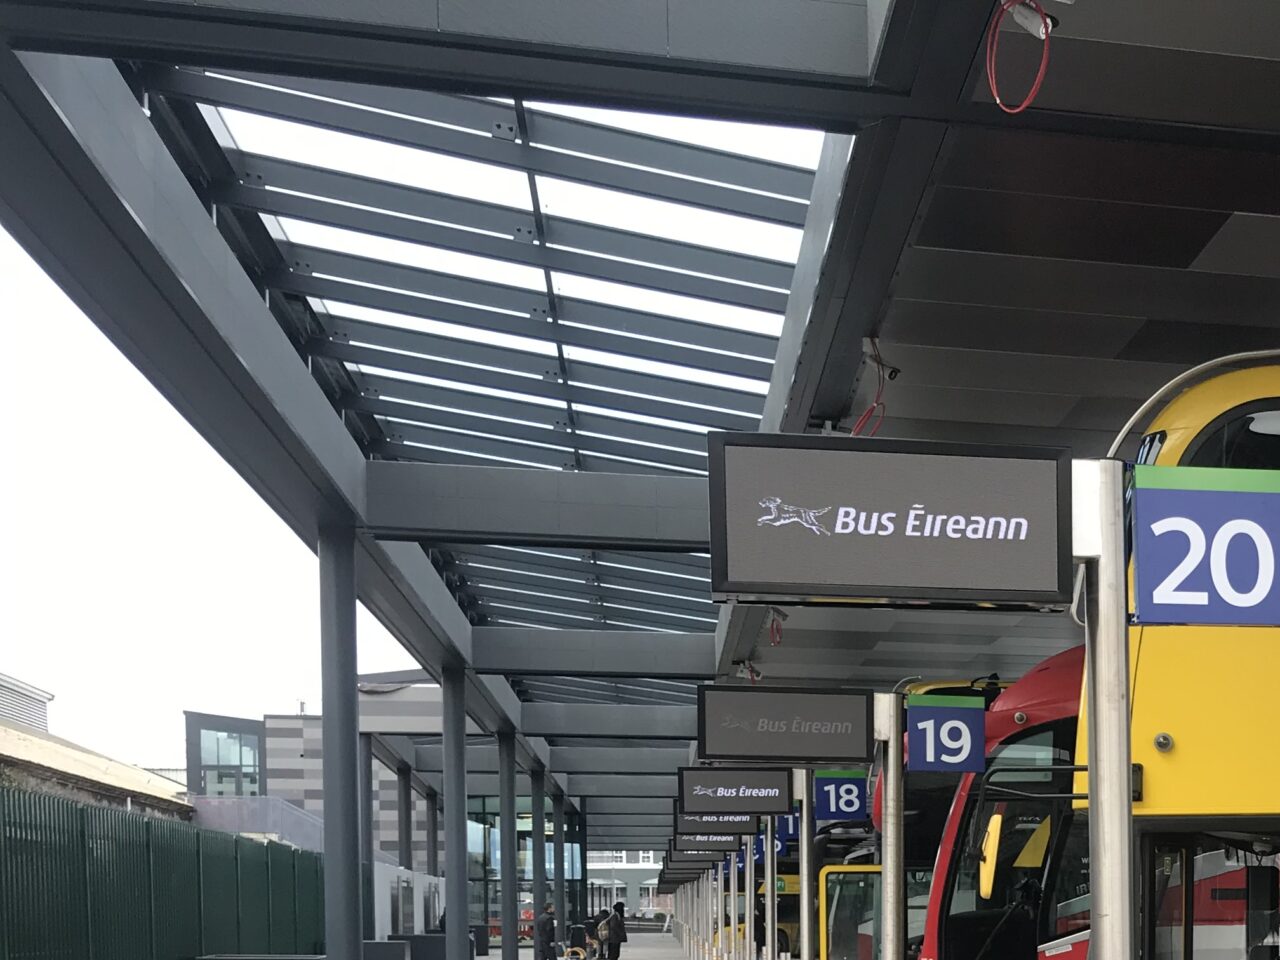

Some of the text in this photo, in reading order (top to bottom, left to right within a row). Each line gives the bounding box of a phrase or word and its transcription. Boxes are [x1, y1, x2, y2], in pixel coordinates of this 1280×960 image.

[834, 506, 897, 537] Bus
[1150, 516, 1276, 608] 20
[756, 718, 787, 733] Bus
[916, 718, 972, 764] 19
[716, 787, 737, 797] Bus
[823, 784, 861, 813] 18
